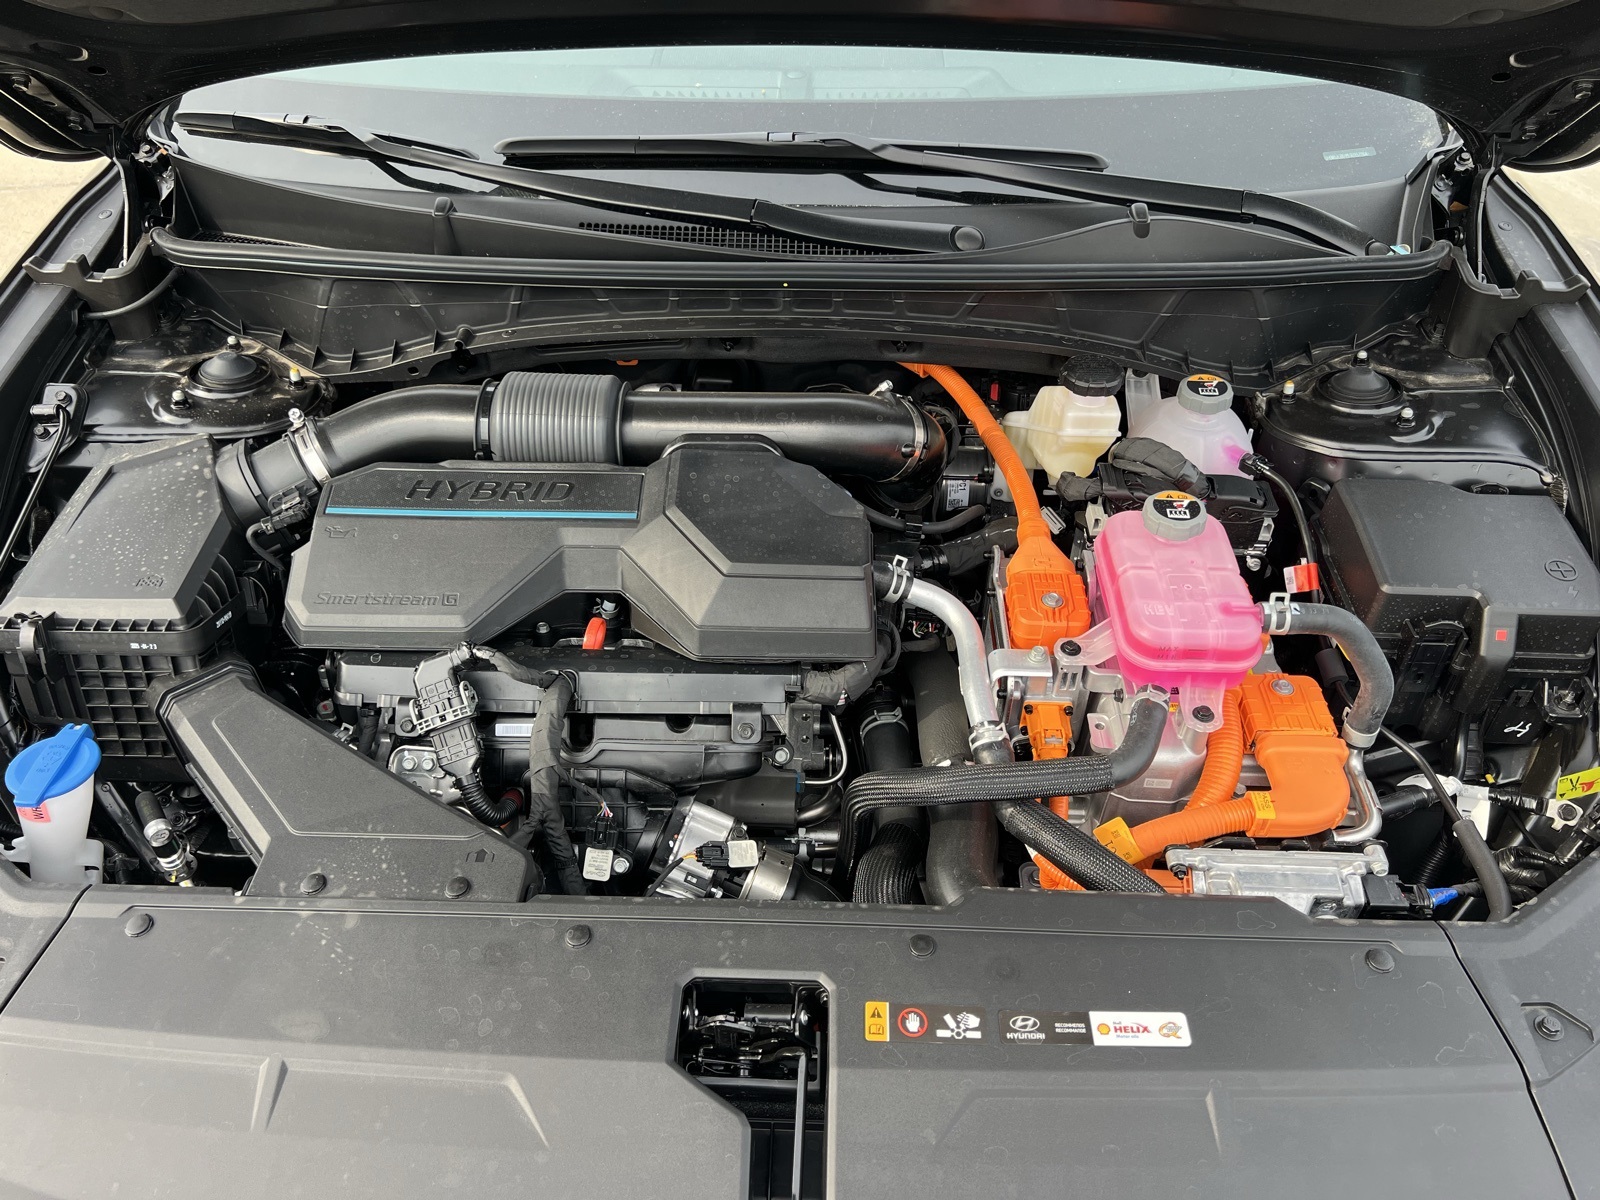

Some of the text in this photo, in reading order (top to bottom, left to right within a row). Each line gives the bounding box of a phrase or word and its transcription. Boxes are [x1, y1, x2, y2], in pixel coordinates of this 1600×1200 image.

[404, 479, 575, 502] HYBRID
[313, 591, 440, 606] Smartstream
[1113, 1025, 1152, 1034] HELIX
[1006, 1032, 1046, 1040] HYUNDAI
